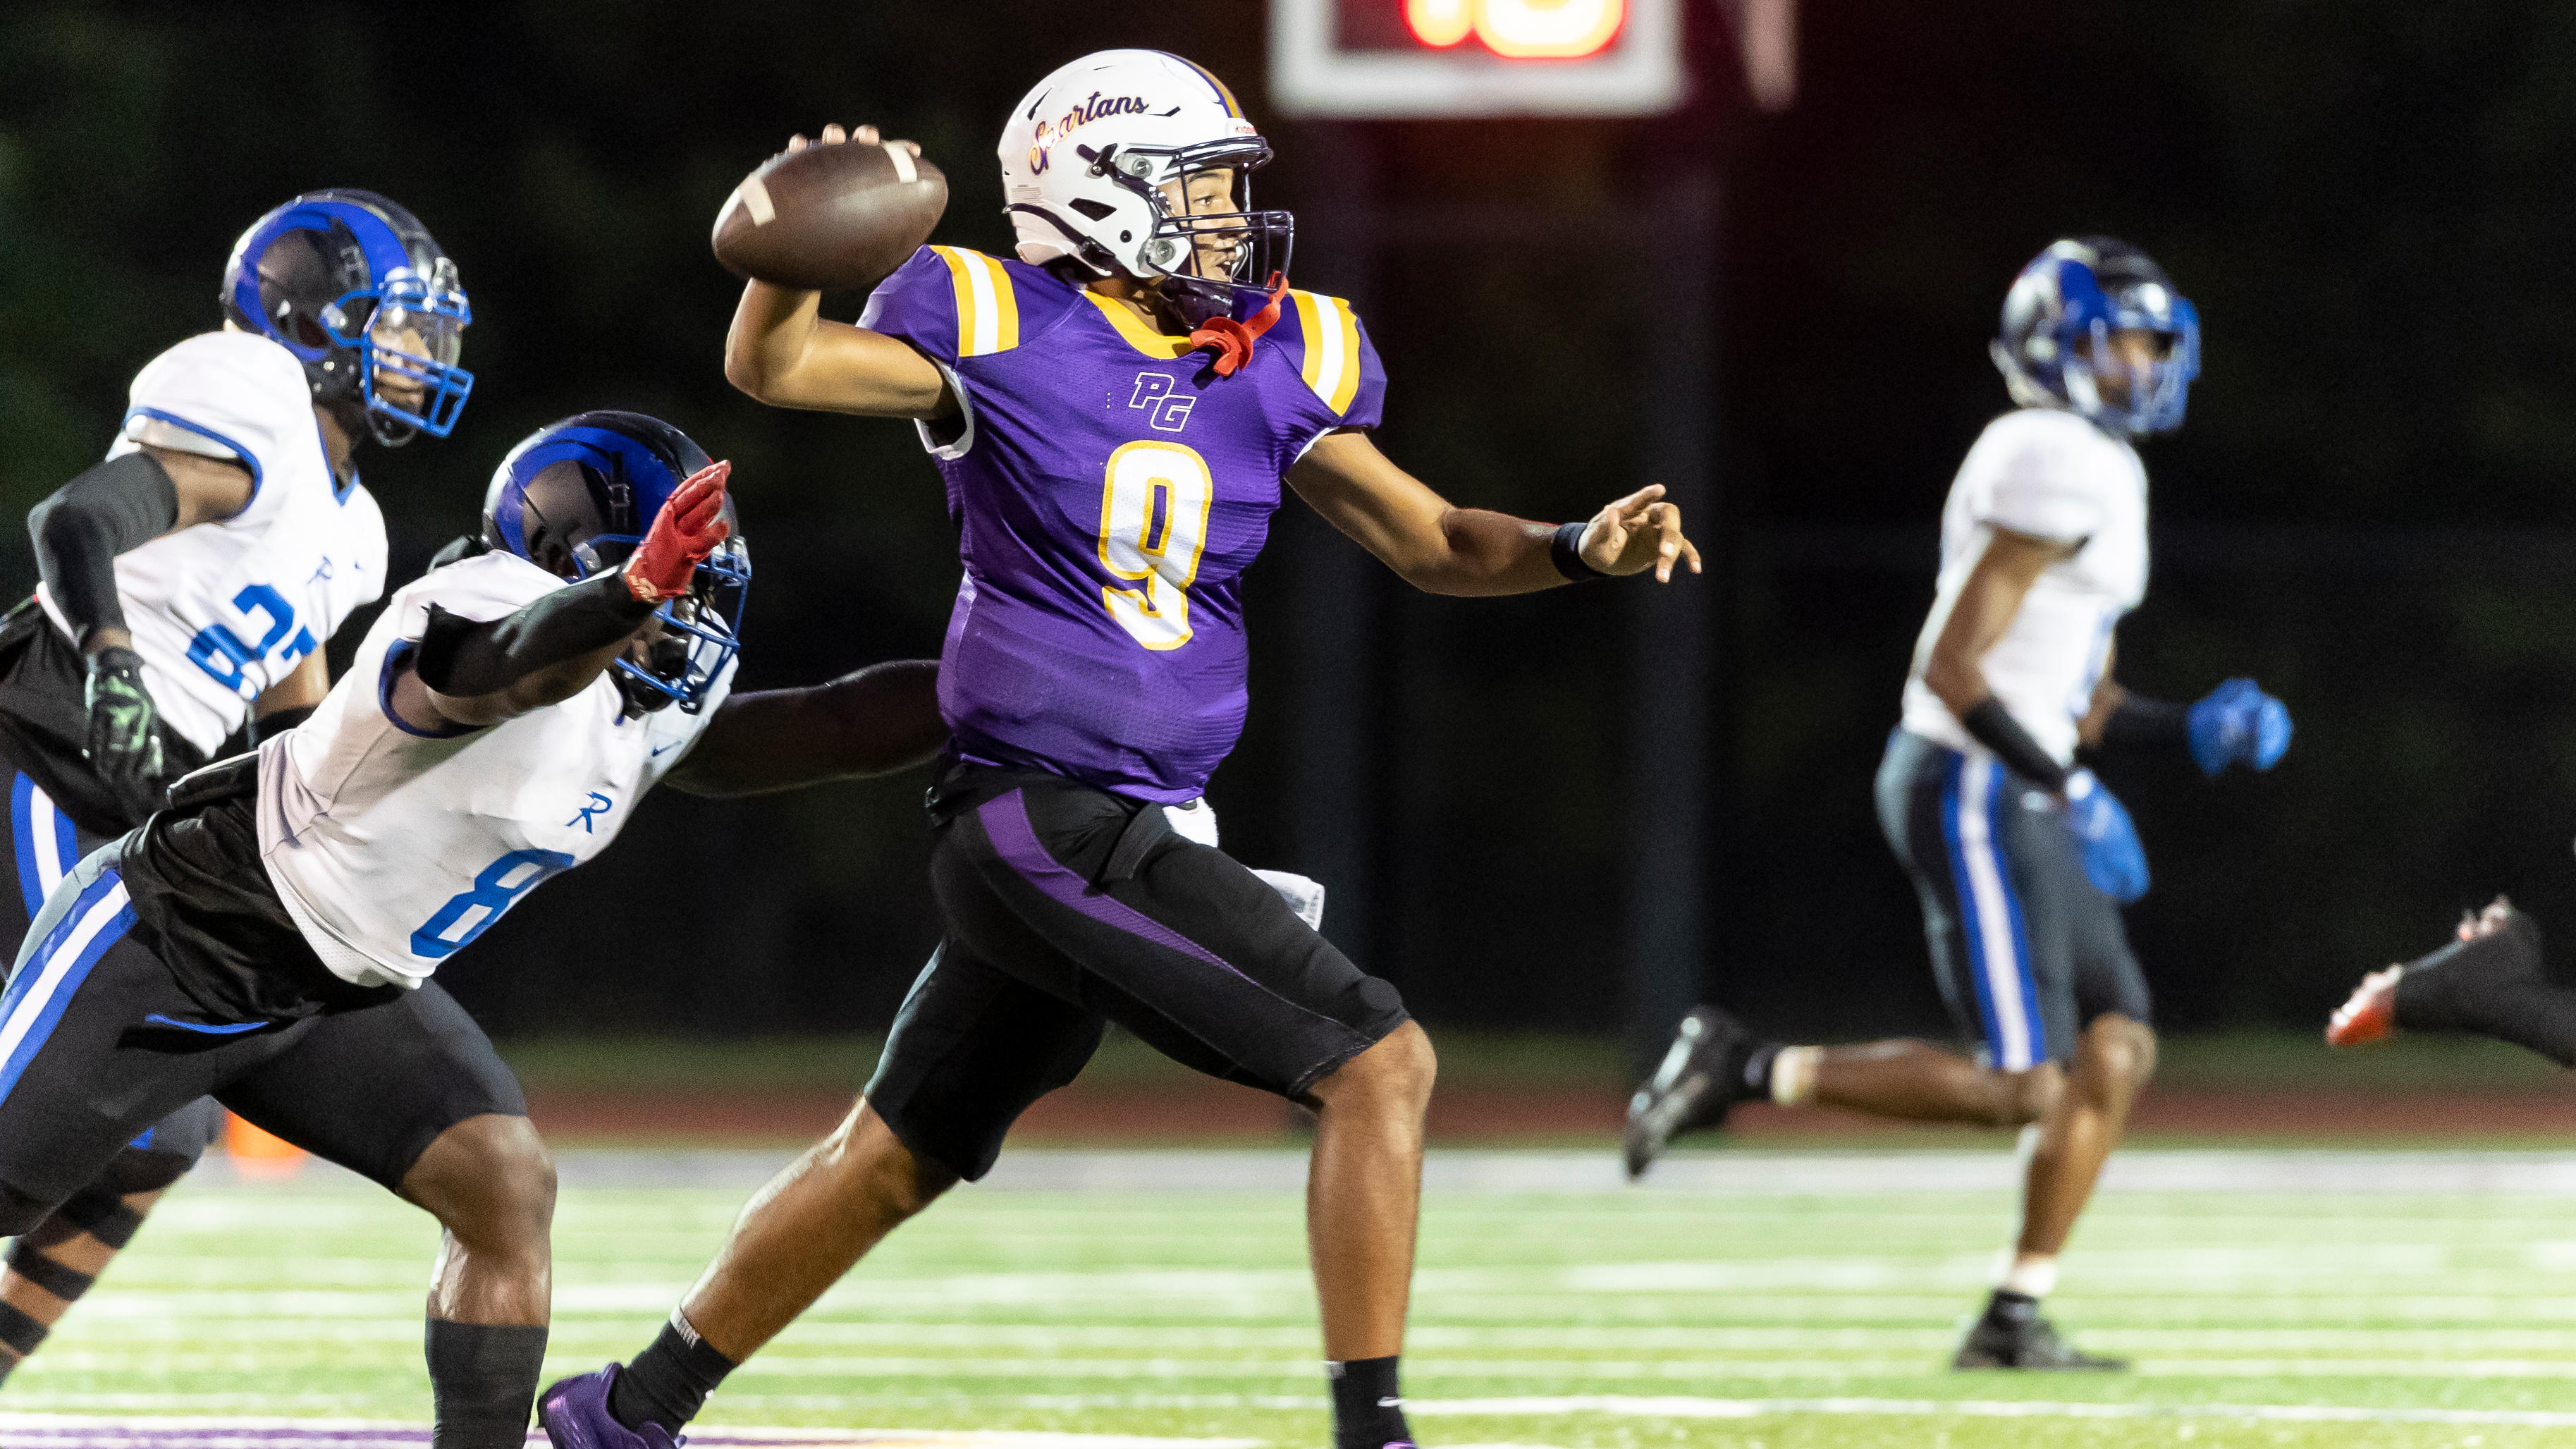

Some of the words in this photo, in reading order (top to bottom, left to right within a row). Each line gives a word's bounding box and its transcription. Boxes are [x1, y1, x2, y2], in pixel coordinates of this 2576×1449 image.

[1129, 372, 1196, 432] PG
[1098, 439, 1213, 651] 9
[564, 790, 613, 835] R
[410, 848, 575, 959] 8
